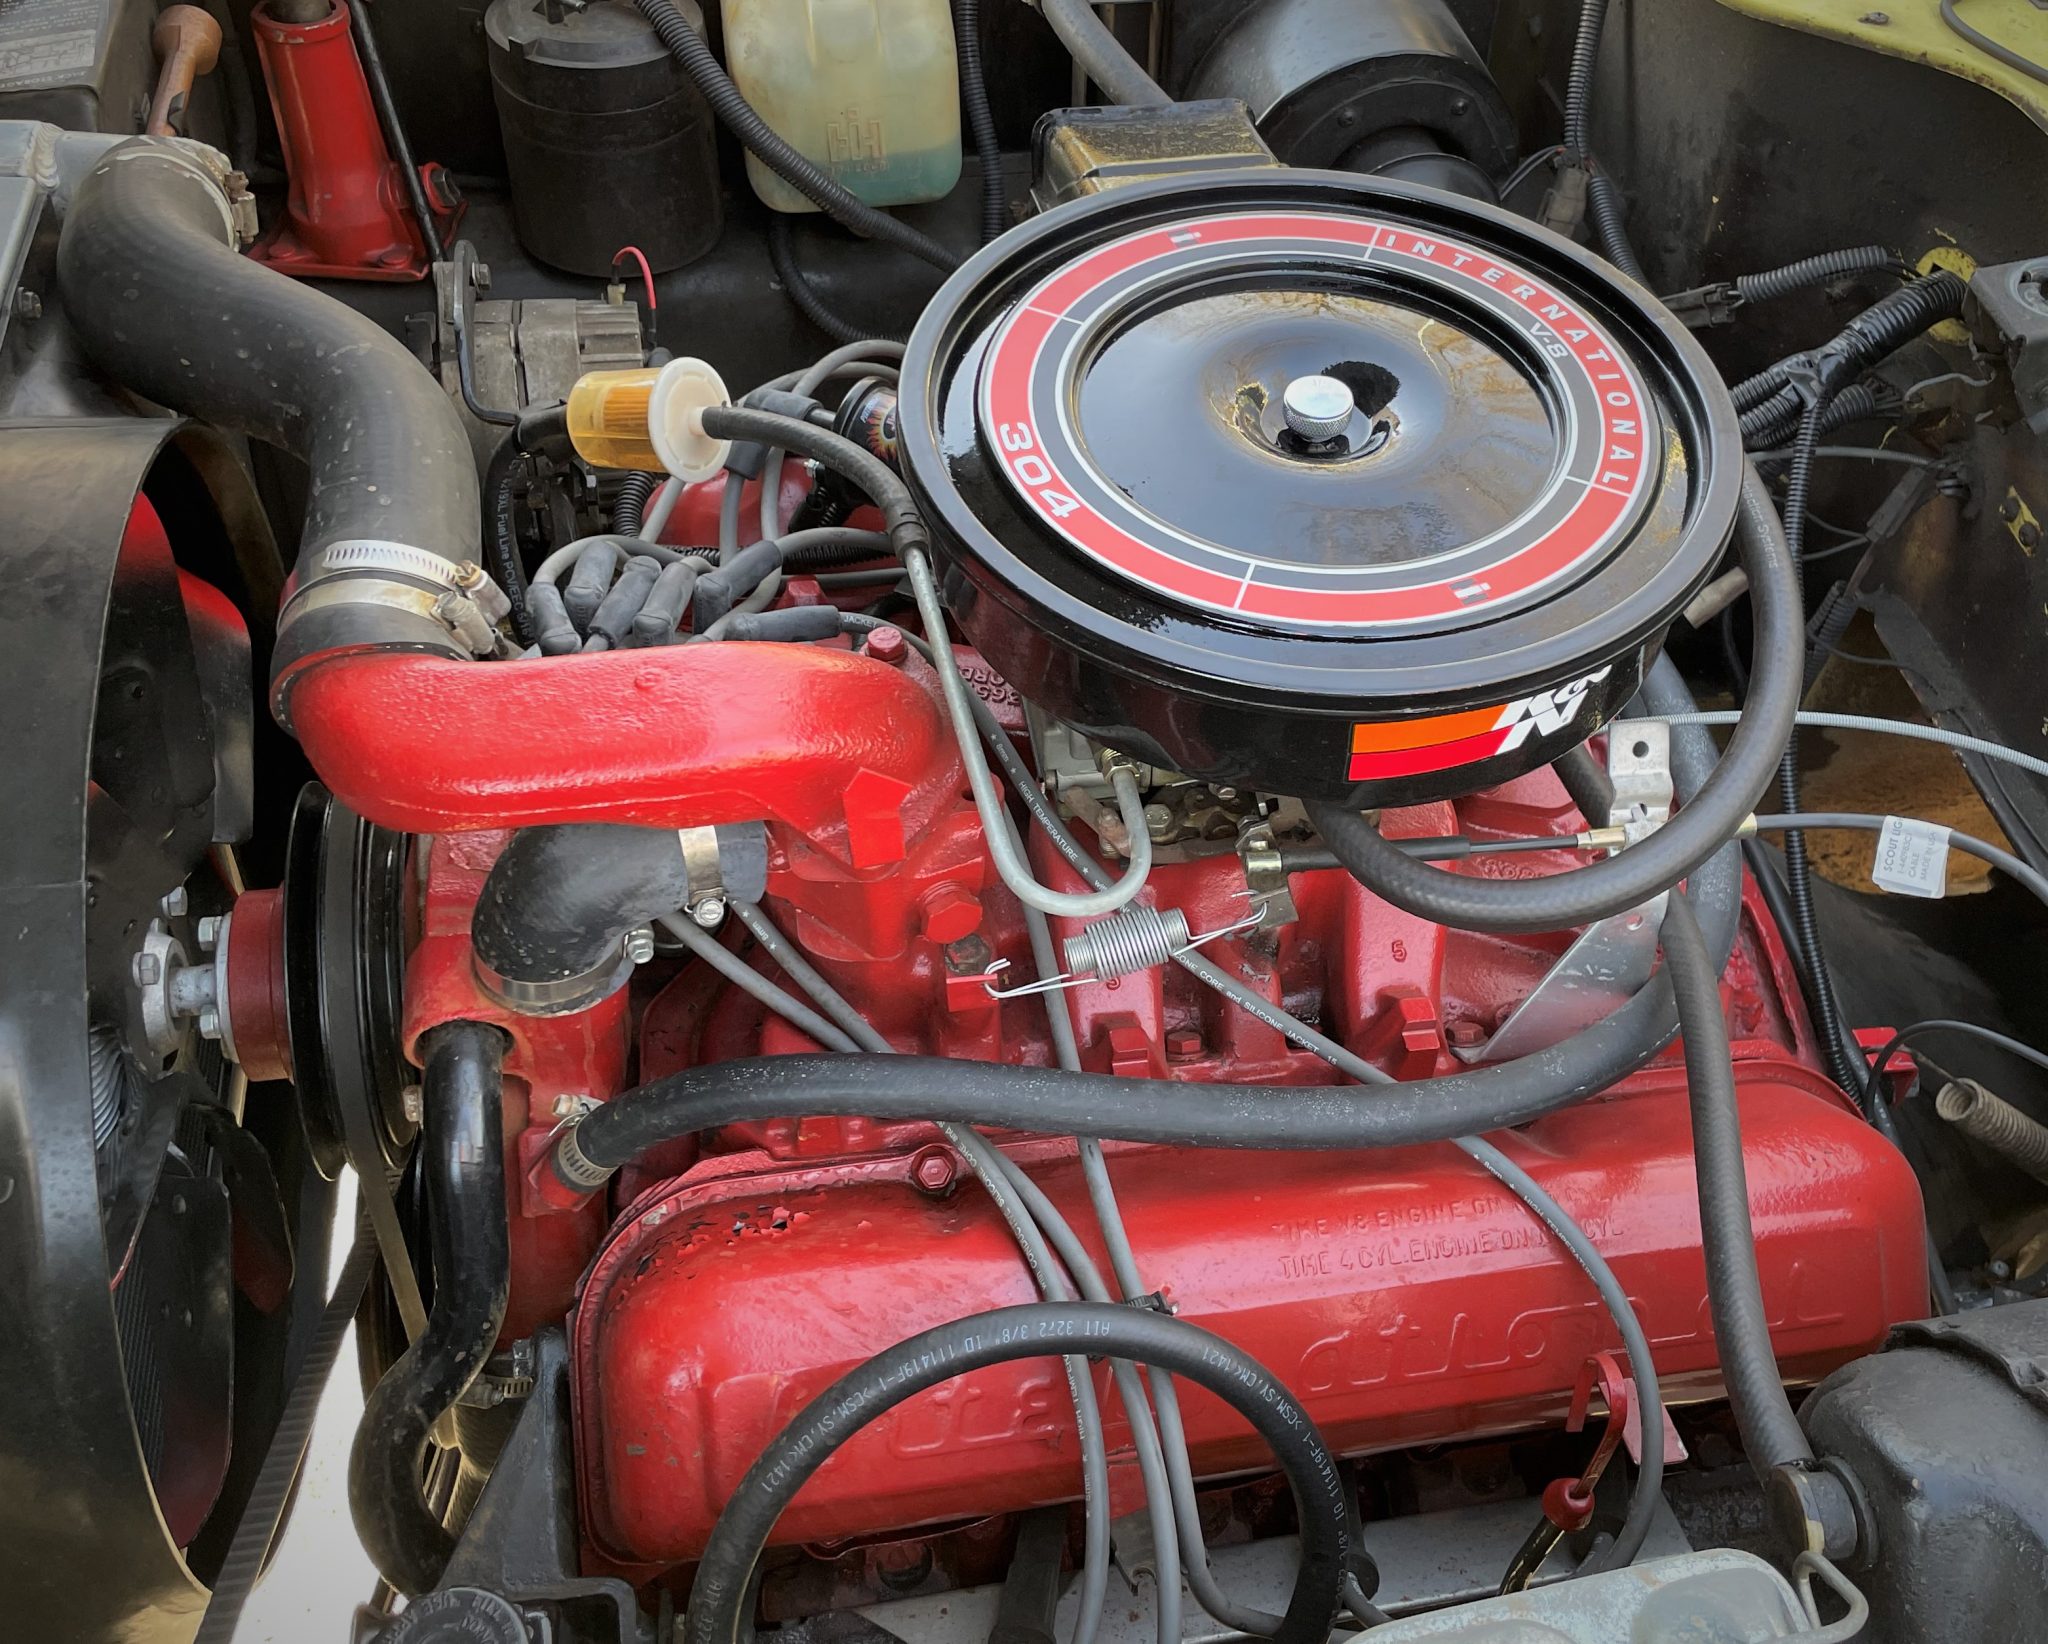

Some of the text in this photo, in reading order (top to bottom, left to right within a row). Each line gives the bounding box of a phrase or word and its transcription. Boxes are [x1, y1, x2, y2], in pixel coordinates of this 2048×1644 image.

[1529, 321, 1569, 360] V-8
[1385, 234, 1637, 484] INTERNATIONAL
[999, 421, 1082, 519] 304
[496, 513, 509, 535] Fuel
[498, 537, 510, 559] Line
[1756, 523, 1779, 569] Systems
[501, 560, 525, 611] PCV/EEC
[843, 614, 876, 628] JACKET
[1490, 664, 1612, 756] K&N
[995, 742, 1107, 892] 8mm HIGH TEMPERATURE wit
[1882, 837, 1899, 872] SCOUT
[1907, 852, 1920, 878] CABLE
[1918, 856, 1931, 880] MADE
[1926, 830, 1937, 846] USA
[751, 920, 769, 941] 8mm
[1198, 969, 1225, 991] CORE
[1225, 988, 1242, 1003] and
[1242, 1000, 1283, 1030] SILICONE
[1284, 1028, 1319, 1053] JACKET
[1326, 1054, 1337, 1065] 15
[944, 1125, 958, 1142] and
[957, 1141, 977, 1167] CORE
[977, 1166, 1005, 1207] SILICONE
[1374, 1199, 1466, 1231] ENGINE
[1277, 1250, 1332, 1279] TIME
[1499, 1227, 1529, 1250] ON
[963, 1334, 984, 1353] ID
[994, 1324, 1029, 1344] 3/8"
[1038, 1319, 1074, 1337] 3272
[1084, 1320, 1110, 1336] AIT
[877, 1343, 955, 1391] 111419F-1
[1201, 1346, 1231, 1372] 1421
[1075, 1409, 1085, 1439] HIGH
[759, 1458, 792, 1493] 1421
[1301, 1431, 1338, 1497] 111419F-1
[703, 1579, 722, 1607] AIT
